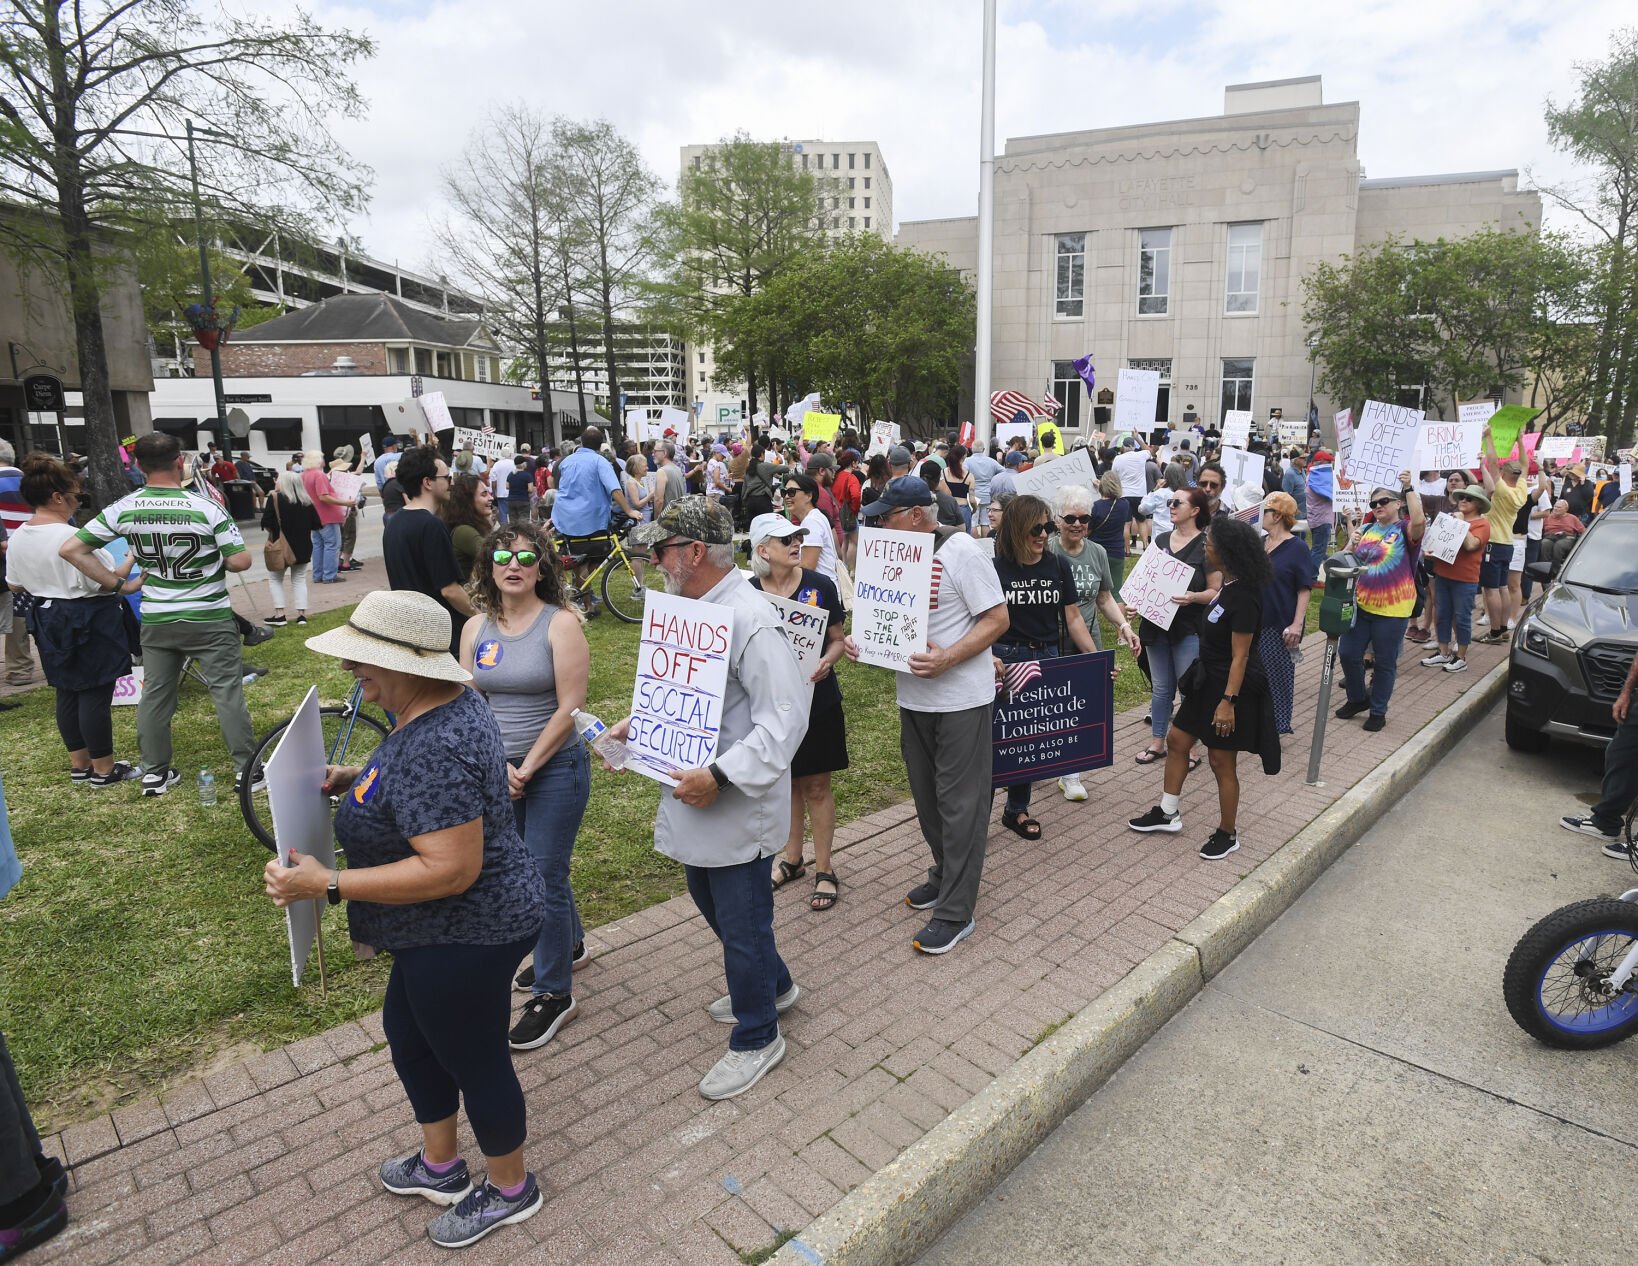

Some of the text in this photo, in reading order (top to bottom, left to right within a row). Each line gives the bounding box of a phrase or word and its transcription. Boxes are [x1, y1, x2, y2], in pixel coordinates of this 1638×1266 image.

[719, 408, 730, 422] P
[1366, 401, 1419, 428] HANDS
[458, 429, 473, 437] THIS
[1361, 441, 1404, 468] FREE
[1434, 441, 1462, 455] THEM
[1434, 452, 1469, 469] HOME
[135, 500, 192, 508] MAGNERS
[133, 514, 192, 526] McGREGOR
[1437, 530, 1456, 544] GOP
[129, 532, 205, 580] 42
[864, 539, 923, 563] VETERAN
[882, 566, 903, 582] FOR
[1073, 573, 1096, 581] ULD
[1143, 564, 1158, 584] THE
[1162, 560, 1190, 583] OFF
[1010, 578, 1054, 589] GULF OF
[1076, 581, 1094, 589] MY
[857, 581, 917, 608] DEMOCRACY
[1006, 590, 1060, 605] MEXICO
[1076, 589, 1098, 597] TER
[873, 609, 900, 622] STOP
[1144, 605, 1167, 626] PBS
[649, 608, 729, 654] HANDS
[877, 622, 894, 633] THE
[788, 631, 817, 650] ECH
[864, 630, 901, 647] STEAL
[651, 647, 707, 684] OFF
[1009, 680, 1072, 705] Festival
[639, 682, 718, 732] SOCIAL
[993, 695, 1086, 724] America de
[1001, 715, 1080, 740] Louisiane
[626, 716, 716, 768] SECURITY
[998, 735, 1079, 757] WOULD ALSO BE
[1018, 749, 1062, 765] PAS BON
